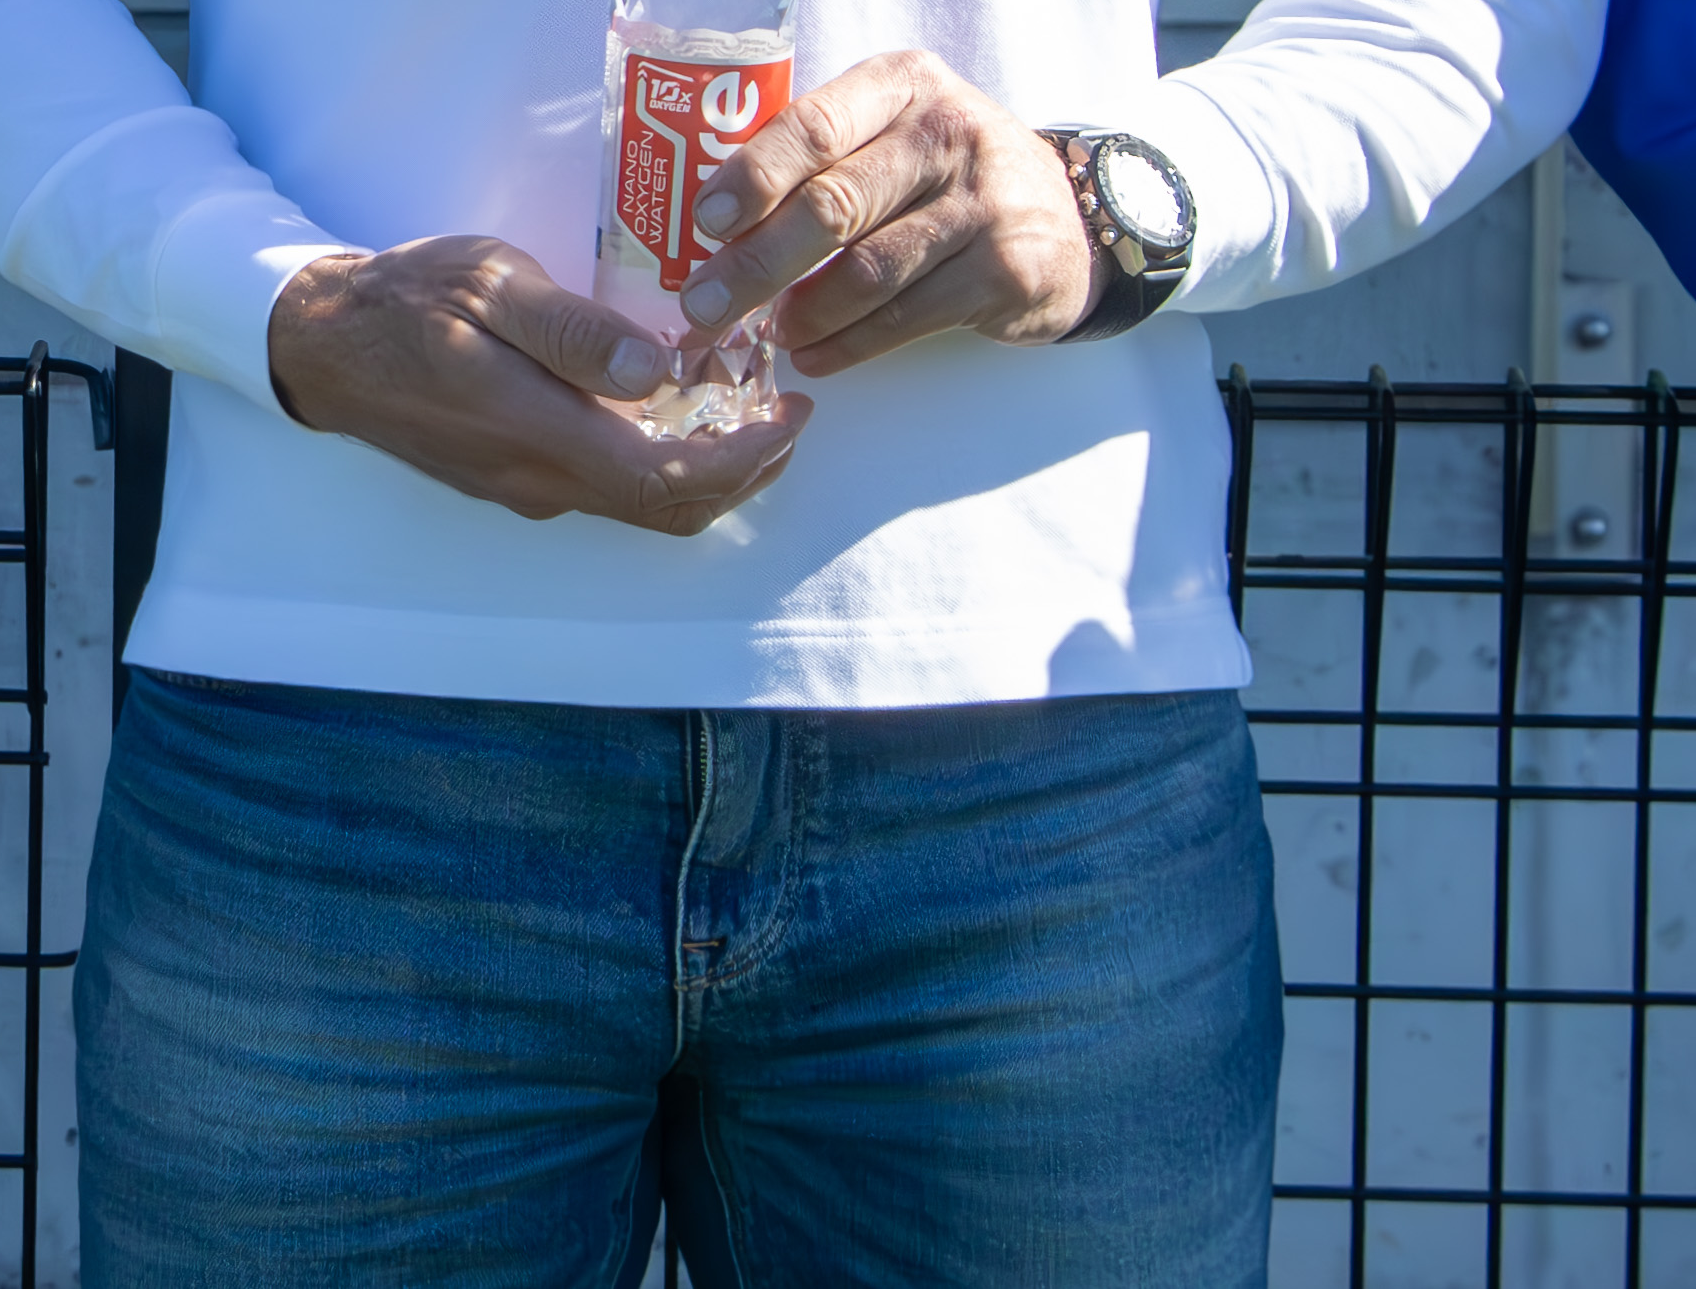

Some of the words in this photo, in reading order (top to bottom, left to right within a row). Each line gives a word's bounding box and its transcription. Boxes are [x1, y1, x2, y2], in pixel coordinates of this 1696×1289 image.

[649, 99, 692, 114] OXYGEN
[622, 139, 639, 213] NANO
[634, 129, 655, 236] OXYGEN
[649, 157, 669, 246] WATER
